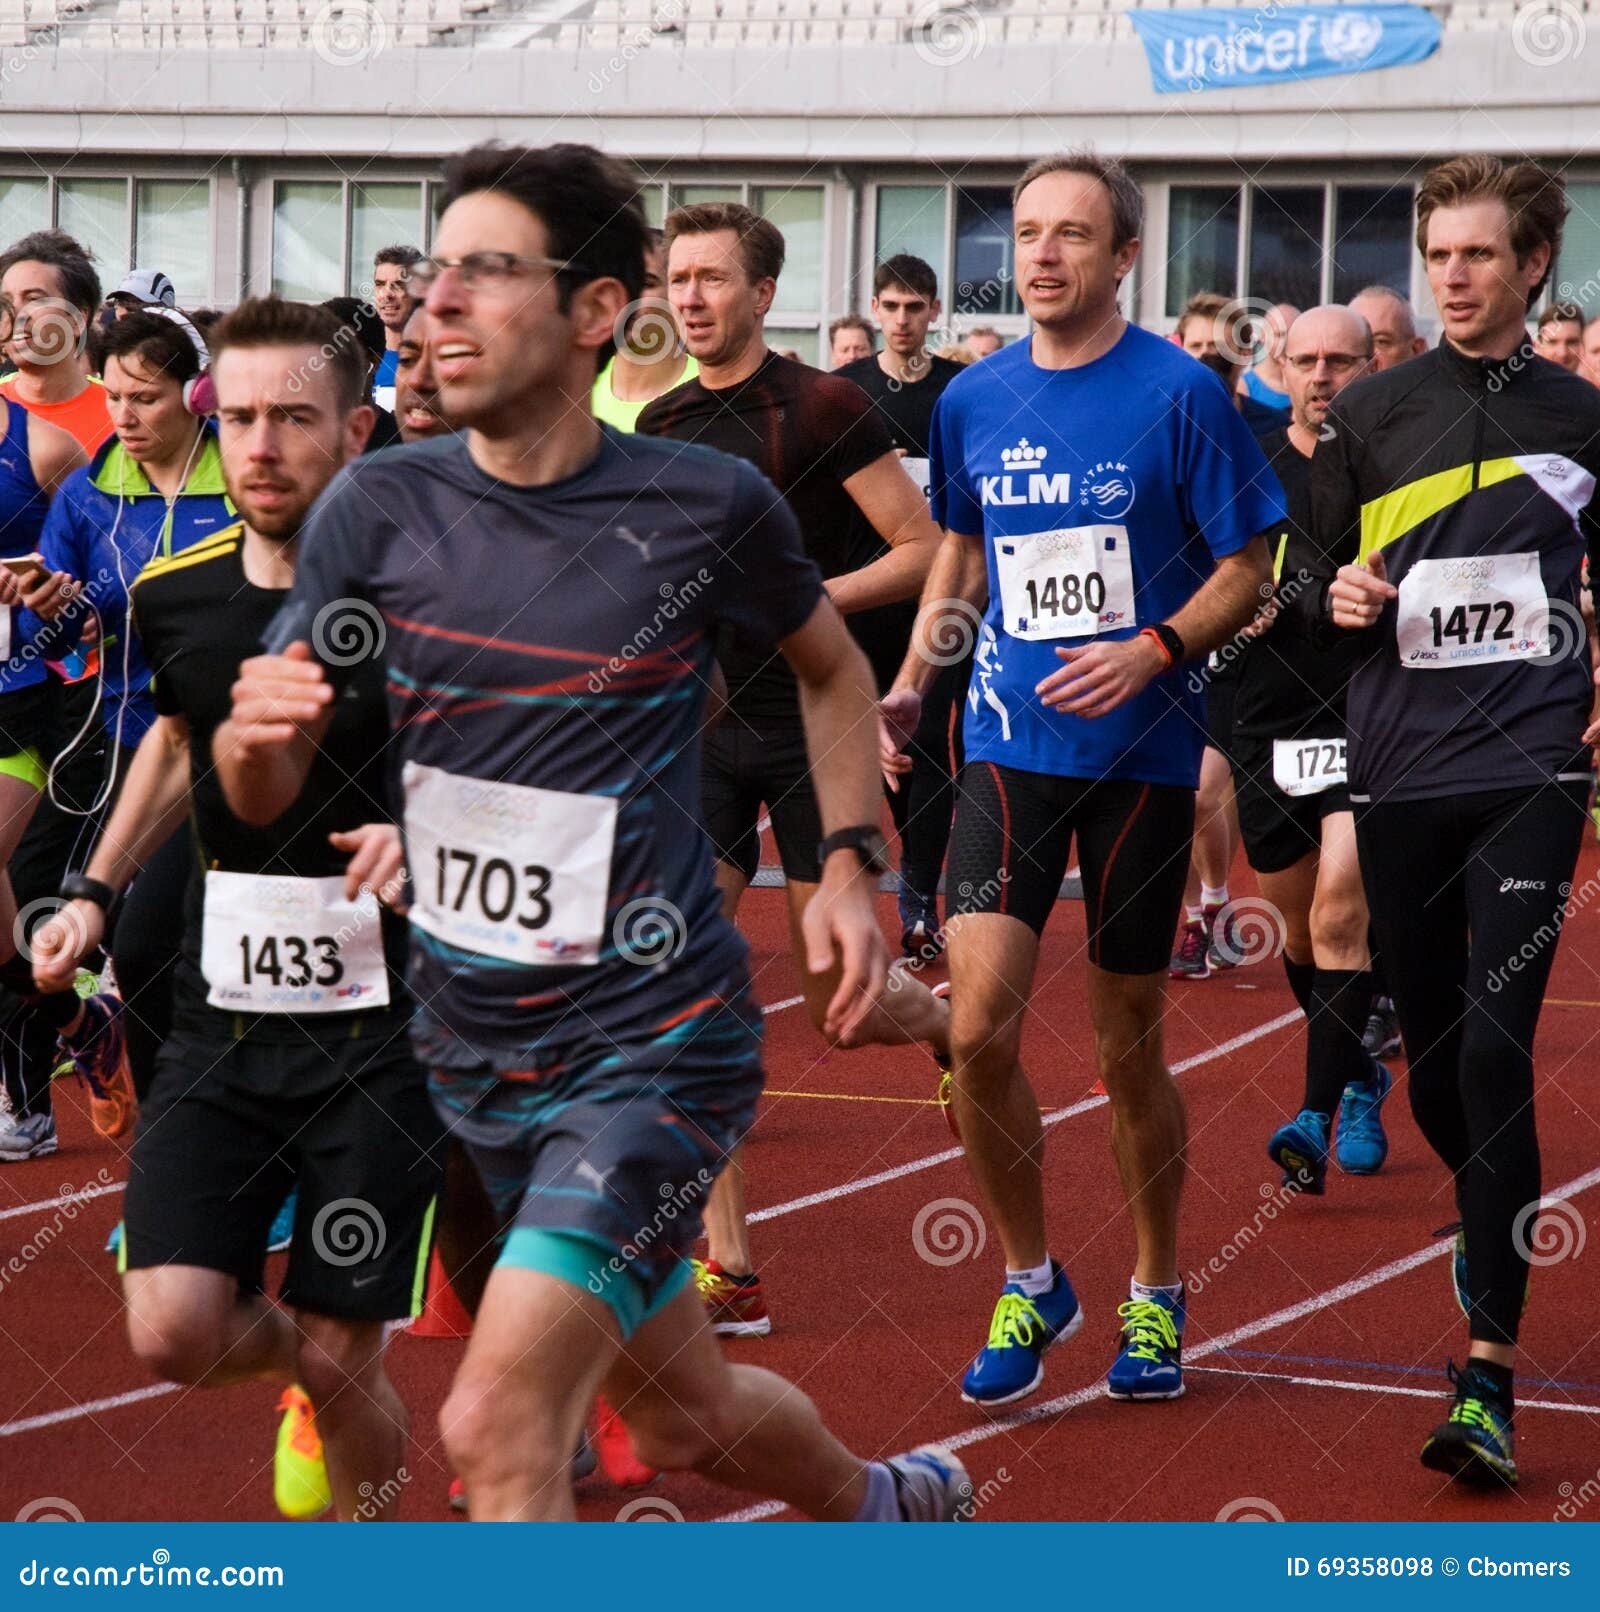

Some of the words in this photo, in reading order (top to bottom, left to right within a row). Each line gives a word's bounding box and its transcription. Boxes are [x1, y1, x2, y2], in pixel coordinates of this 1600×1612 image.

[1164, 14, 1317, 80] unicef
[981, 473, 1071, 506] KLM
[1079, 461, 1128, 506] SKYTEAM
[1025, 571, 1106, 619] 1480
[1430, 601, 1515, 647] 1472
[1418, 651, 1440, 660] asics
[1450, 646, 1486, 659] unicef
[436, 847, 553, 931] 1703
[1512, 879, 1547, 891] asics
[239, 934, 345, 987] 1433
